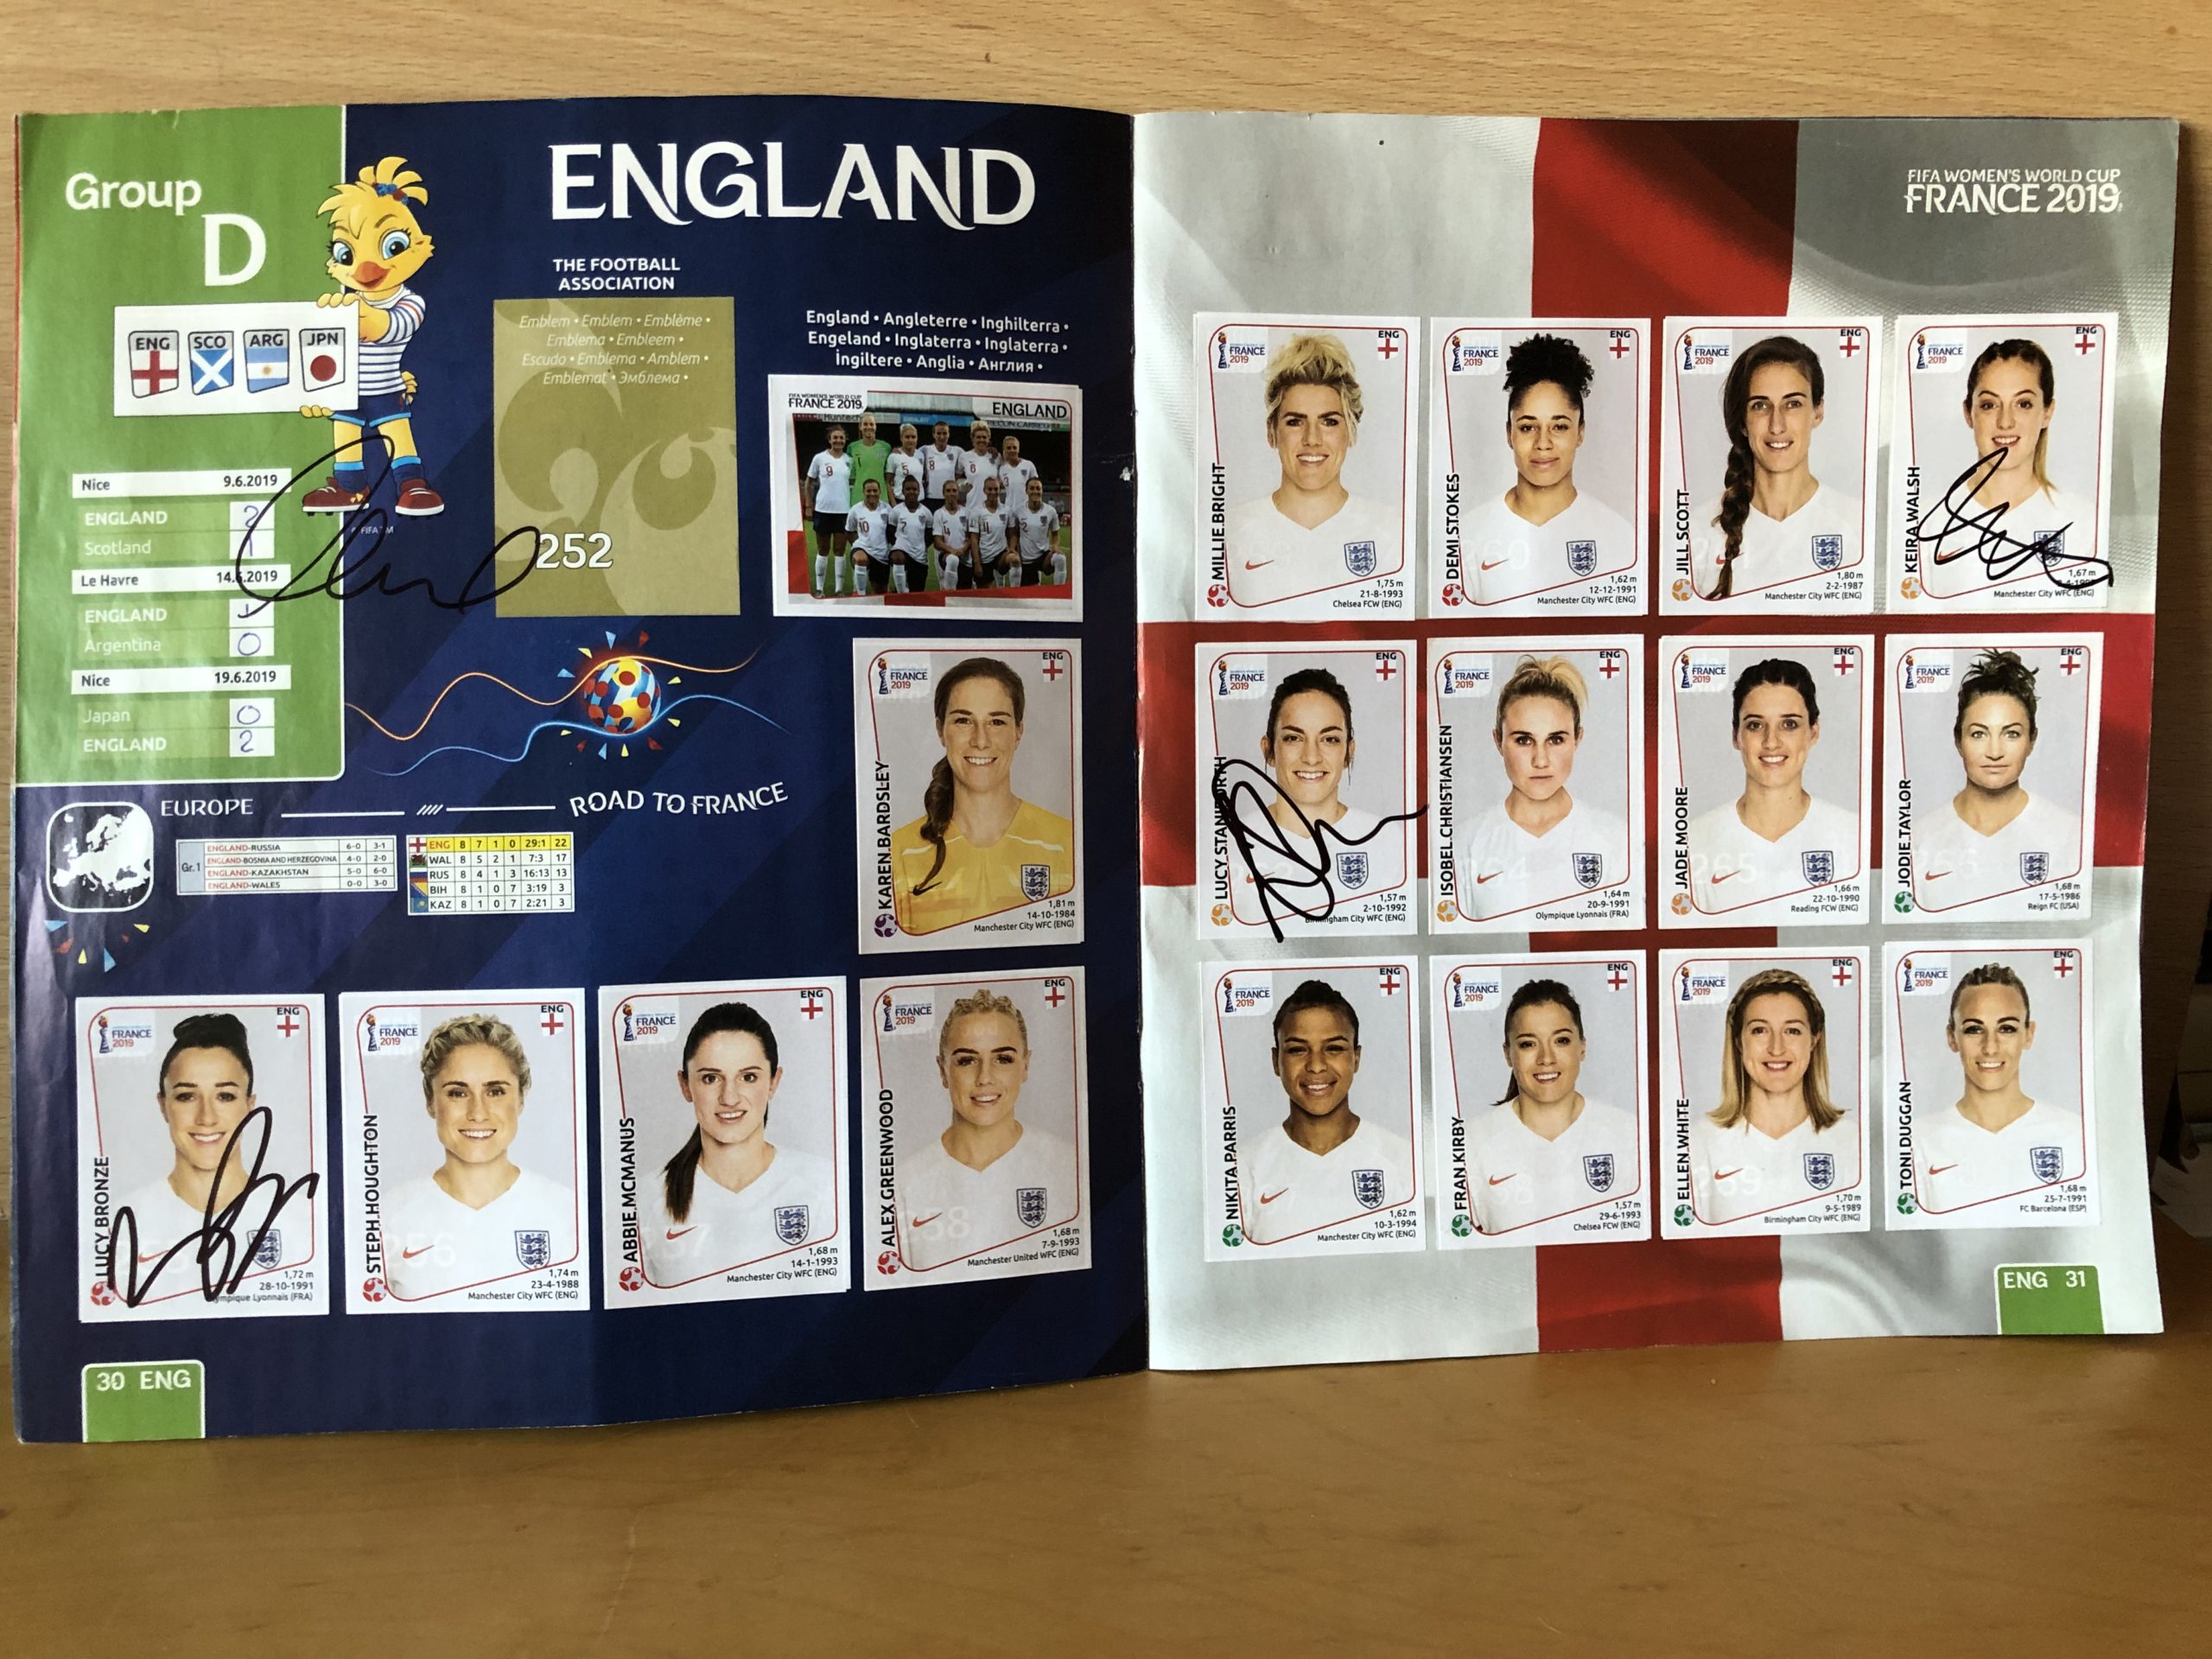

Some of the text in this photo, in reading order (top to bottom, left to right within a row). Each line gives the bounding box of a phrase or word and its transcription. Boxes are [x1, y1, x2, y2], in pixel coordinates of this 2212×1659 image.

[1908, 168, 2120, 182] FIFA WOMEN'S WORLD CUP
[66, 173, 202, 215] Group
[549, 142, 1035, 231] ENGLAND
[1904, 183, 2121, 214] FRANCE 2019
[203, 213, 266, 286] D
[553, 257, 680, 272] THE FOOTBALL
[558, 276, 675, 291] ASSOCIATION
[519, 314, 702, 327] Emblem Emblem Emblème
[806, 310, 1060, 334] England Angleterre Inghilterra
[194, 335, 226, 349] SCO
[249, 334, 283, 347] ARG
[308, 332, 339, 346] JPN
[547, 333, 675, 346] Emblema Embleem
[808, 331, 1058, 353] Engeland Inglaterra Inglaterra
[1378, 330, 1399, 339] ENG
[135, 337, 169, 351] ENG
[1230, 346, 1266, 356] FRANCE
[522, 352, 700, 365] Escudo Emblema Amblem
[916, 355, 964, 372] Anglia
[979, 359, 1033, 373] Англия
[1230, 355, 1249, 364] 2019
[543, 372, 606, 385] Emblemat
[619, 372, 679, 384] Эмблема
[789, 398, 835, 410] FRANCE
[994, 403, 1067, 419] ENGLAND
[81, 475, 277, 491] Nice 9.6.2019
[85, 511, 168, 525] ENGLAND
[1211, 463, 1224, 581] MILLIE BRIGHT
[1905, 467, 1920, 573] KEIRA WALSH
[1446, 474, 1459, 579] DEMI STOKES
[1676, 489, 1689, 575] JILL SCOTT
[85, 539, 151, 555] Scotland
[536, 532, 613, 569] 252
[81, 575, 98, 587] Le
[100, 575, 138, 586] Havre
[1333, 600, 1362, 608] Chelsea
[1382, 600, 1402, 608] (ENG)
[85, 608, 167, 623] ENGLAND
[84, 639, 161, 655] Argentina
[81, 671, 276, 686] Nice 19.6.2019
[890, 671, 928, 681] FRANCE
[891, 681, 911, 690] 2019
[83, 710, 130, 724] Japan
[84, 737, 166, 752] ENGLAND
[239, 729, 254, 753] 2
[569, 781, 788, 817] ROAD TO FRANCE
[161, 799, 254, 817] EUROPE
[1440, 725, 1454, 896] ISOBEL CHRISTIANSEN
[876, 761, 893, 909] KAREN BARDSLEY
[1675, 787, 1688, 889] JADE MOORE
[1898, 779, 1911, 887] JODIE TAYLOR
[525, 839, 546, 848] 29:1
[555, 838, 567, 847] 22
[1215, 857, 1228, 900] LUCY
[429, 886, 447, 894] BIH
[2039, 893, 2081, 901] 17-5-1986
[1027, 910, 1075, 919] 14-10-1984
[1363, 904, 1407, 912] 2-10-1992
[1535, 910, 1630, 920] Olympique Lyonnais (FRA)
[1899, 1082, 1912, 1189] TONI DUGGAN
[1676, 1098, 1689, 1200] ELLEN WHITE
[879, 1089, 895, 1247] ALEX GREENWOOD
[1224, 1106, 1239, 1220] NIKITA PARRIS
[1452, 1117, 1467, 1210] FRAN KIRBY
[364, 1115, 381, 1273] STEPH HOUGHTON
[620, 1117, 638, 1262] ABBIE MCMANUS
[1599, 1211, 1641, 1220] 29-6-1993
[1825, 1204, 1861, 1213] 9-5-1989
[94, 1157, 110, 1278] LUCY BRONZE
[1375, 1220, 1417, 1230] 10-3-1994
[1042, 1238, 1079, 1248] 7-9-1993
[791, 1258, 838, 1268] 14-1-1993
[259, 1281, 314, 1291] 28-10-1991
[531, 1280, 579, 1288] 23-4-1988
[2004, 1270, 2086, 1289] ENG 31
[468, 1292, 515, 1300] Manchester
[517, 1292, 533, 1301] City
[555, 1291, 578, 1300] (ENG)
[97, 1370, 192, 1391] 30 ENG
